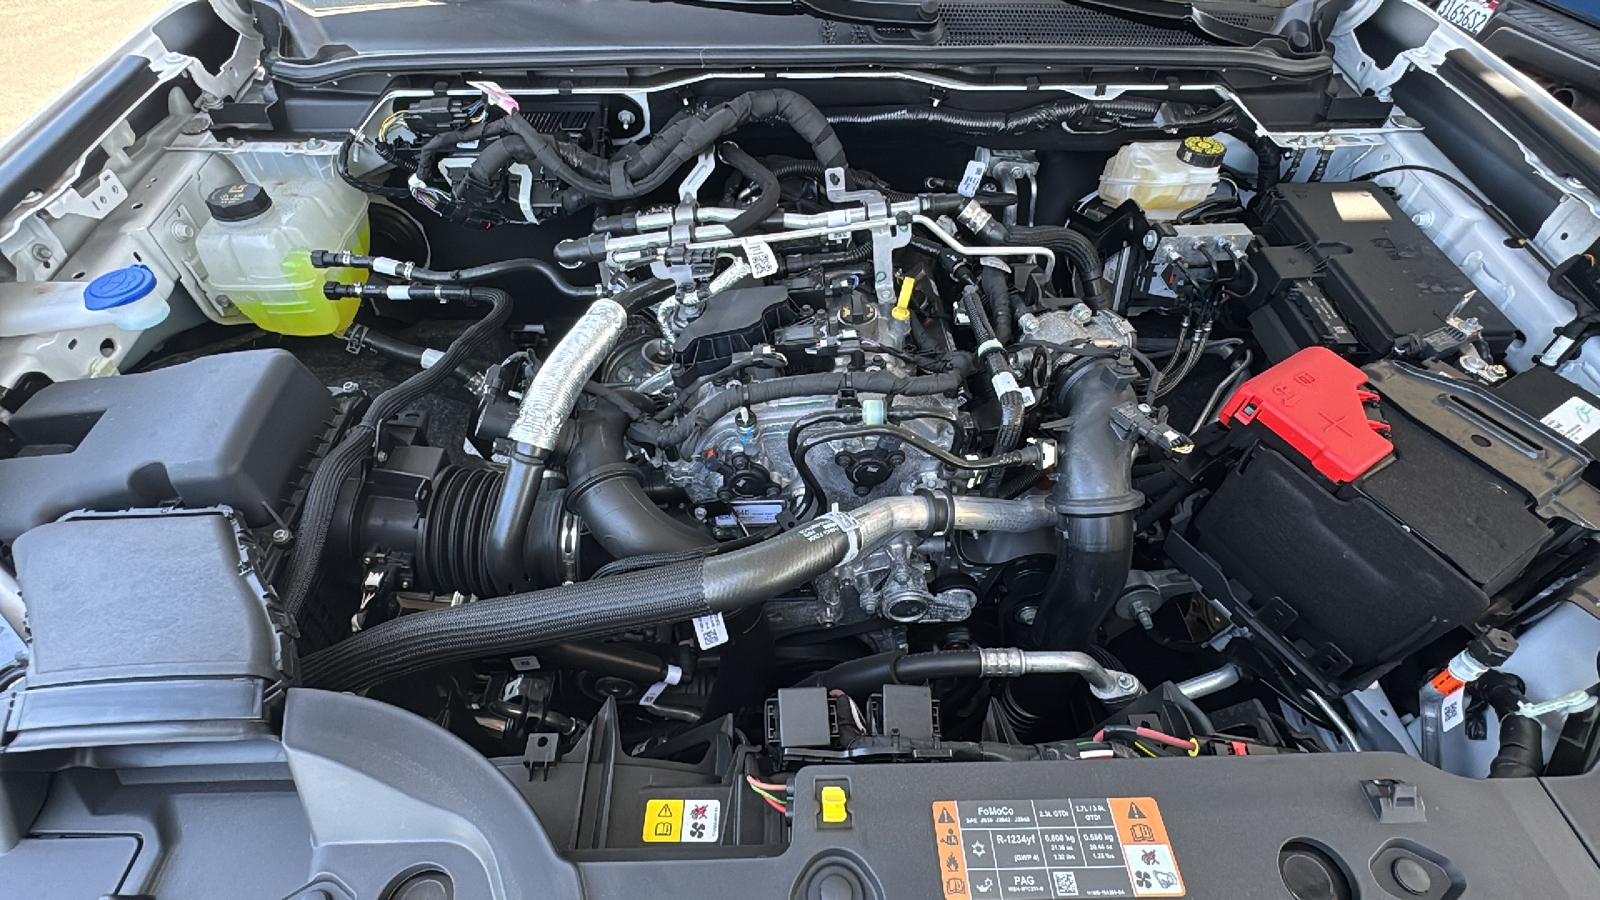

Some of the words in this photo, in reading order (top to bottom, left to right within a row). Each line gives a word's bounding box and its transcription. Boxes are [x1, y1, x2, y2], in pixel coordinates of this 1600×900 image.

[977, 806, 1014, 816] FoMoCo
[996, 834, 1036, 846] R-1234yf
[1065, 834, 1075, 844] kg
[1104, 833, 1114, 842] kg
[1013, 876, 1035, 886] PAG
